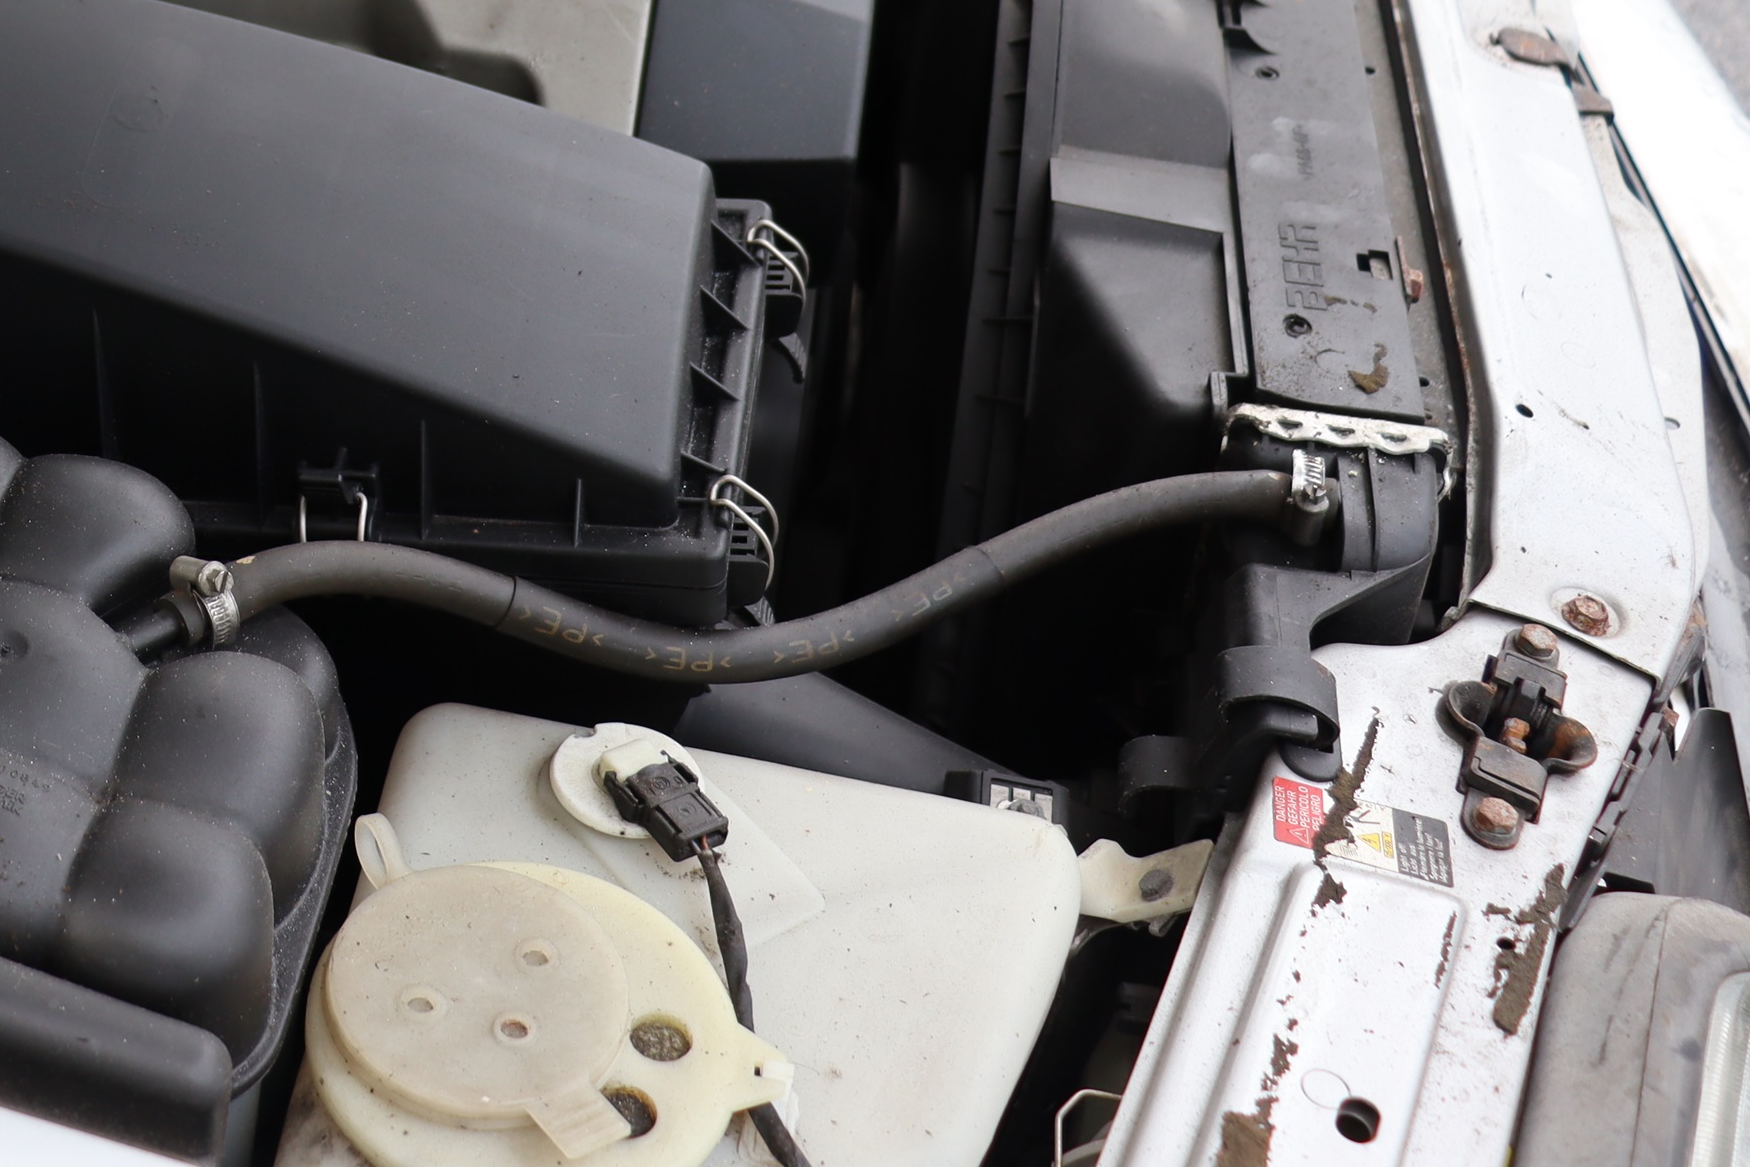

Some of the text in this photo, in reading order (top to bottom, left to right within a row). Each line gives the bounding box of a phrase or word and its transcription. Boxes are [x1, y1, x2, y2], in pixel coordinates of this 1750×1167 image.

[1274, 785, 1285, 822] DANGER
[1287, 791, 1299, 825] GEFAHR
[1298, 786, 1310, 829] PERICOLO
